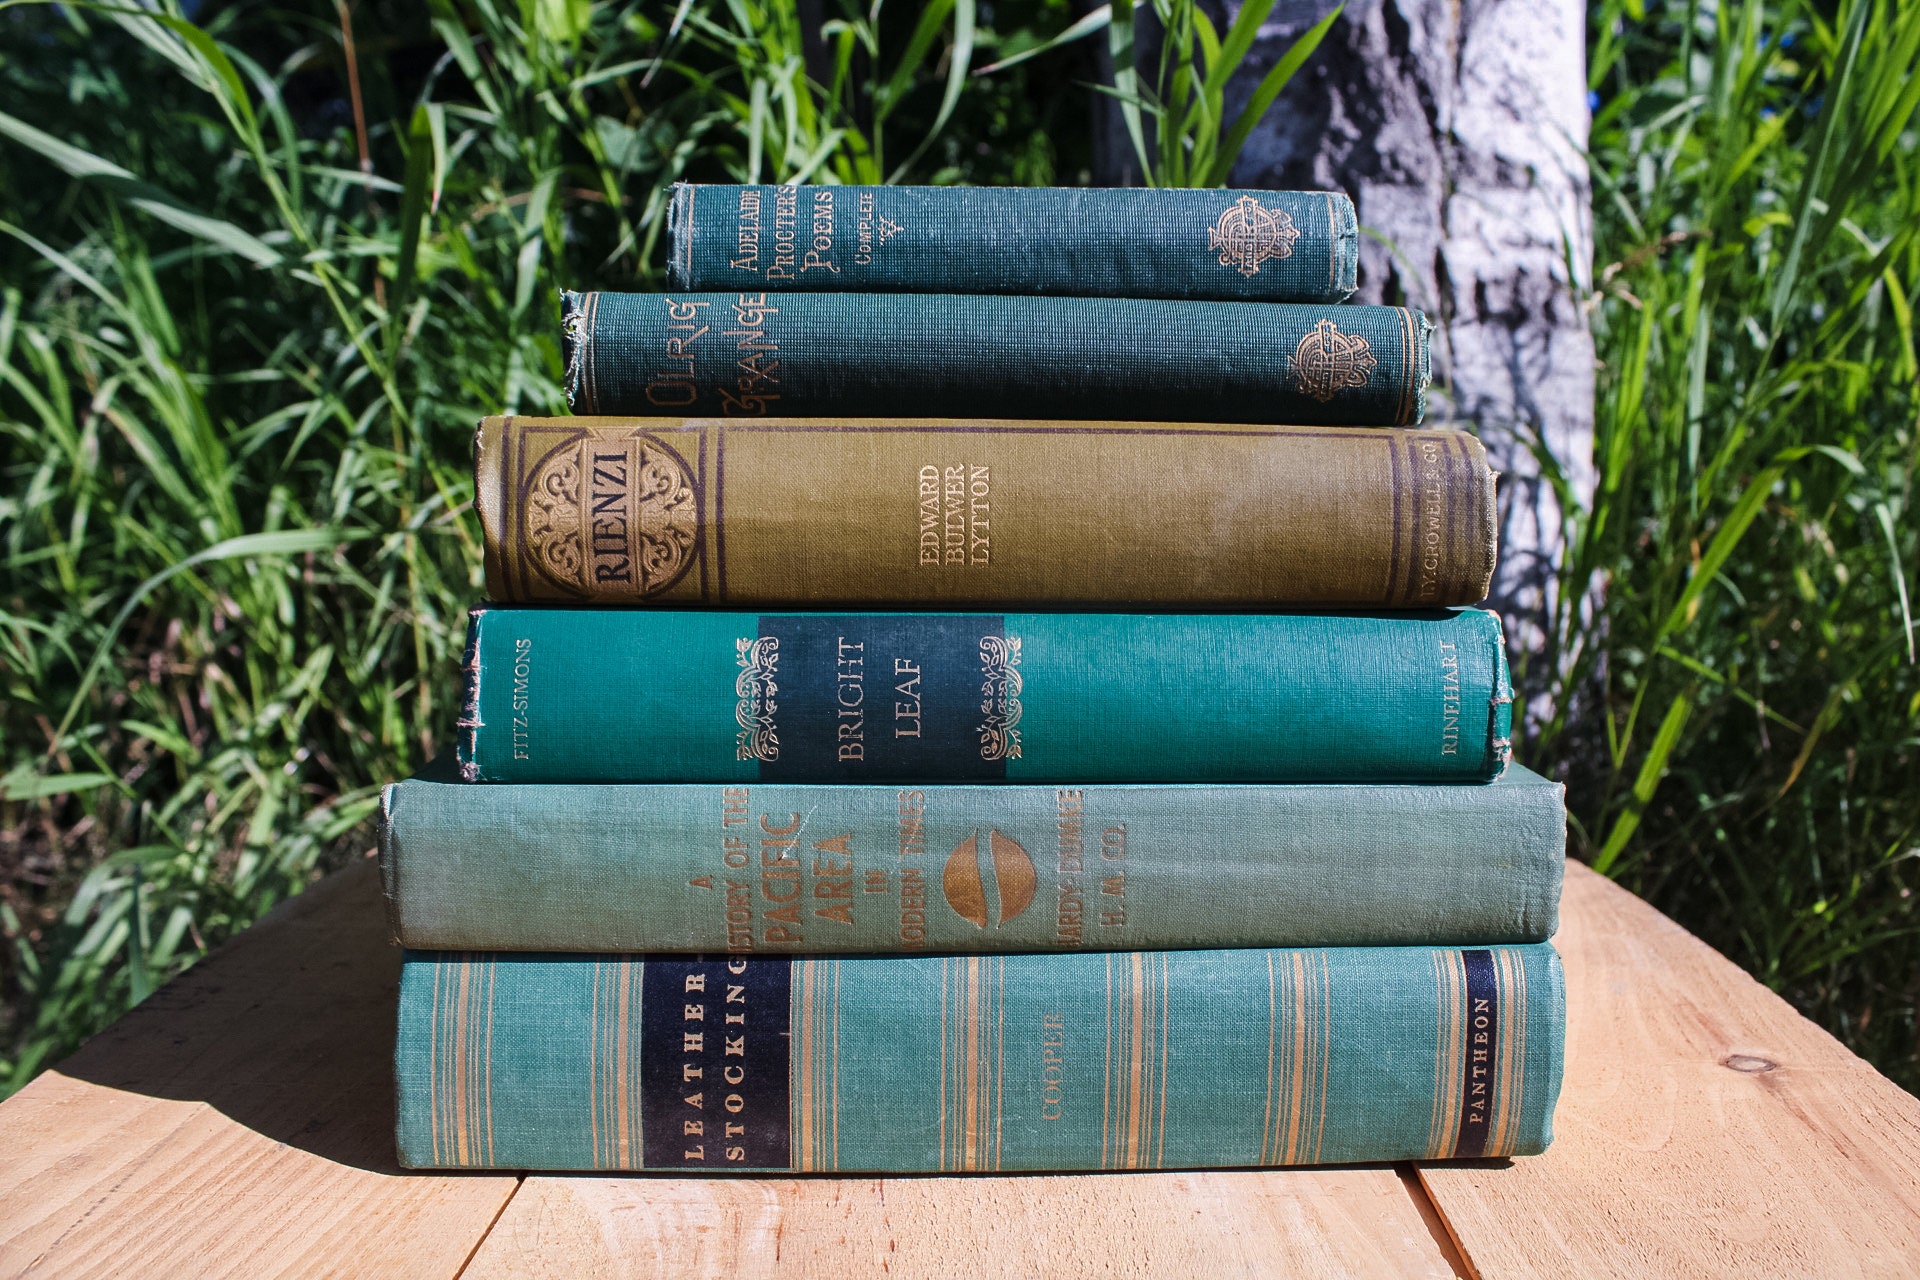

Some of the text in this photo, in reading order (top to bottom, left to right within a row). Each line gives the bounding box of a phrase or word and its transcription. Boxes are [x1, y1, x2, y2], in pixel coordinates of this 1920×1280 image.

[730, 190, 761, 272] ADELAIDE
[766, 185, 797, 281] PROCTER'S
[800, 191, 841, 273] POEMS
[855, 192, 873, 265] COMPLETE
[645, 298, 710, 406] OLRIG
[719, 293, 781, 415] GRANGE
[592, 450, 631, 584] RIENZI
[919, 464, 940, 566] EDWARD
[944, 463, 965, 566] BULWER
[970, 463, 990, 566] LYTTON
[512, 638, 532, 760] FITZ-SIMONS
[837, 636, 864, 762] BRIGHT
[894, 658, 921, 739] LEAF
[1439, 640, 1461, 756] RINEHART
[723, 787, 755, 955] ISTORY OF THE
[898, 789, 925, 860] TIMES
[1100, 823, 1126, 926] H. M. CO.
[689, 874, 713, 891] A
[760, 811, 804, 944] PACIFIC
[812, 833, 854, 925] AREA
[864, 868, 889, 894] IN
[724, 956, 748, 1161] STOCKING
[1042, 1011, 1064, 1120] COOPER
[1469, 998, 1490, 1125] PANTHEON
